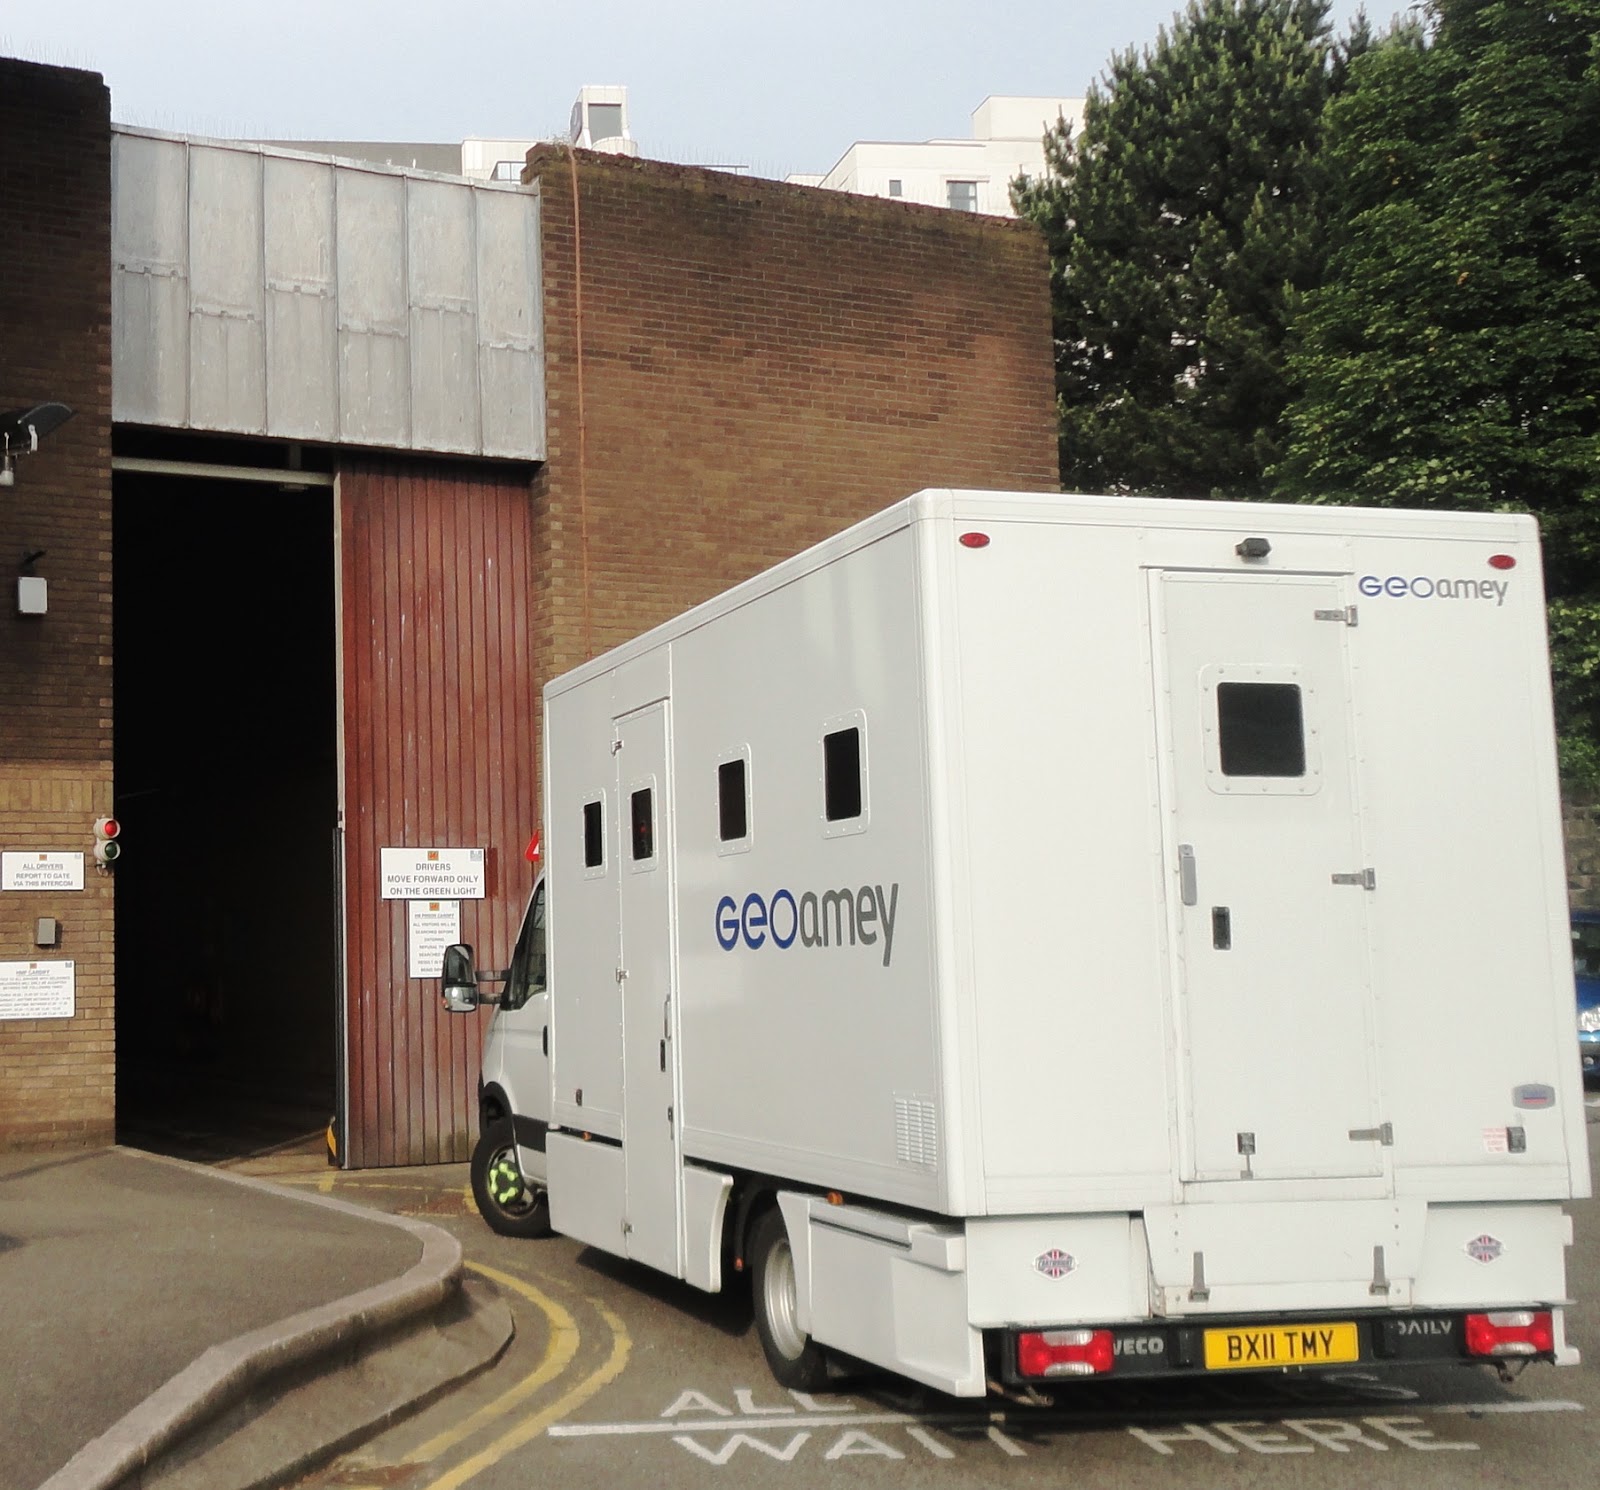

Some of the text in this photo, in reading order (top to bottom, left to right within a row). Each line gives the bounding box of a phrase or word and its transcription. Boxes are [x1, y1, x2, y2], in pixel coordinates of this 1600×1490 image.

[415, 863, 451, 871] DRIVERS
[387, 875, 479, 883] MOVE FORWARD ONLY
[389, 887, 477, 895] ON THE GREEN LIGHT
[1112, 1335, 1164, 1356] VECO
[1226, 1329, 1334, 1362] BX11 TMY
[660, 1388, 857, 1418] ALL
[1128, 1416, 1480, 1455] HERE
